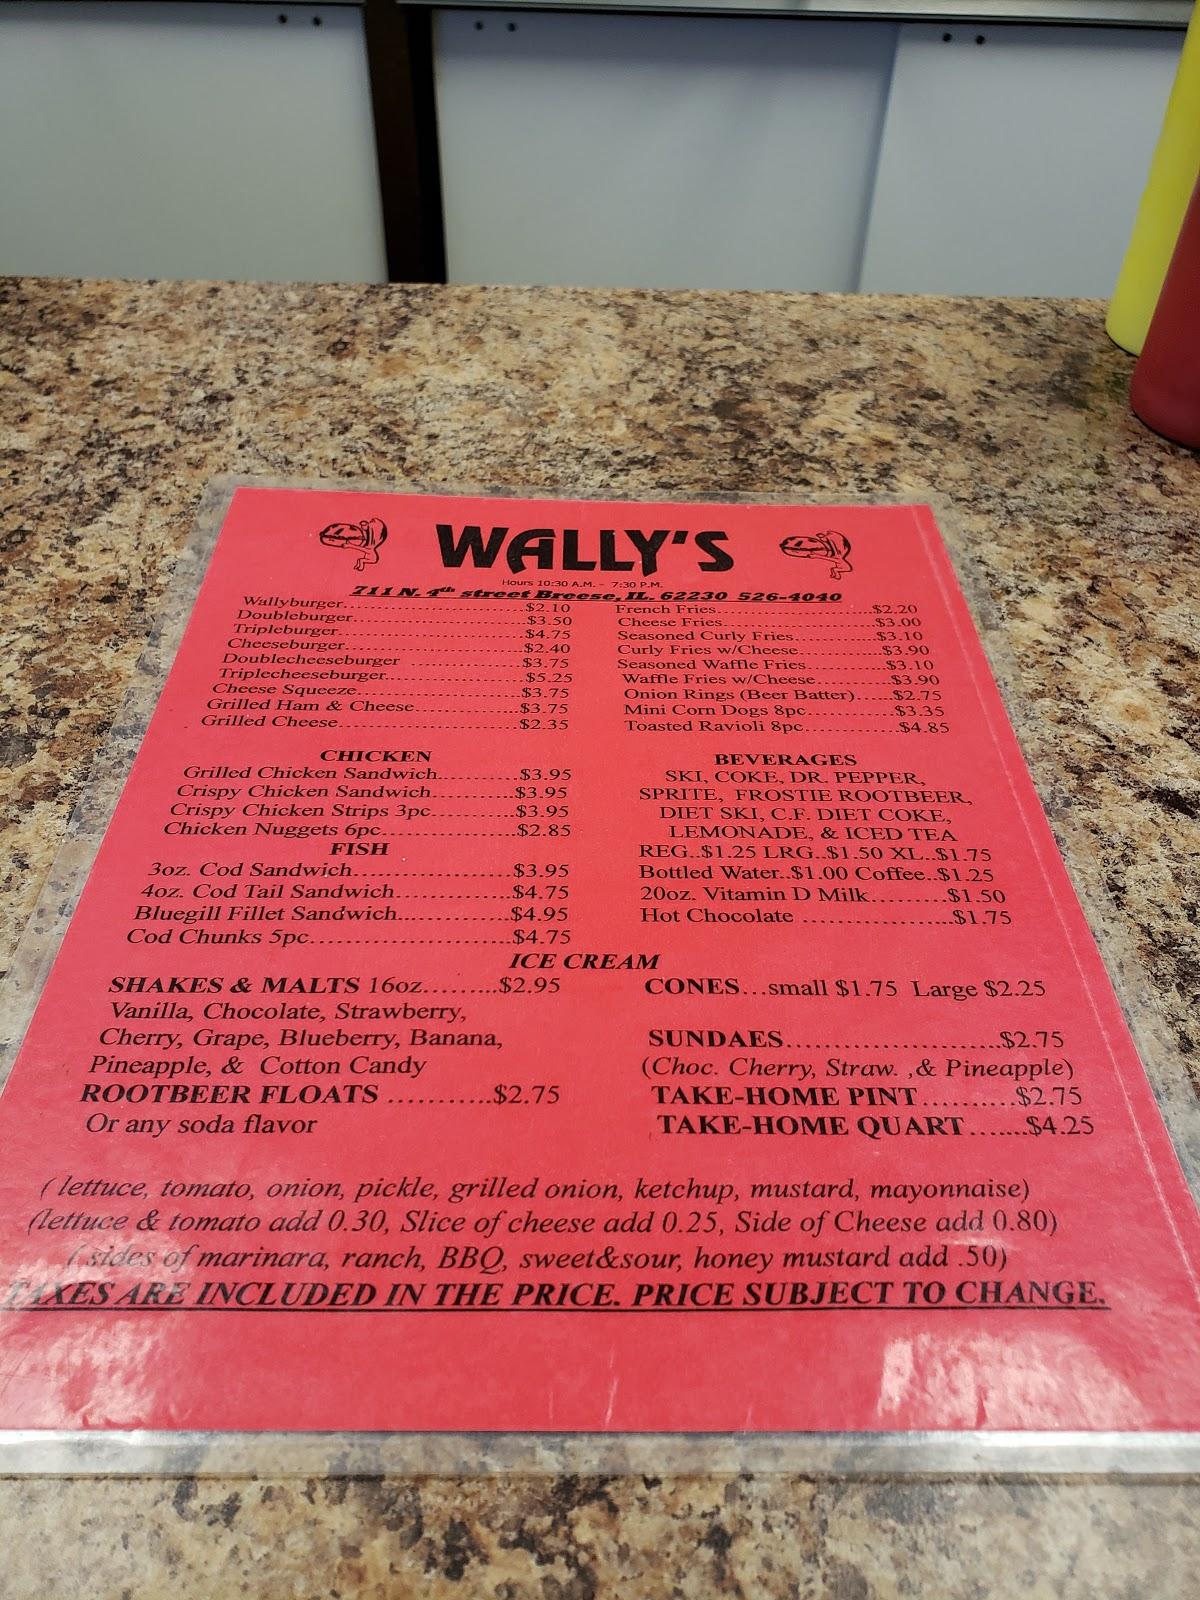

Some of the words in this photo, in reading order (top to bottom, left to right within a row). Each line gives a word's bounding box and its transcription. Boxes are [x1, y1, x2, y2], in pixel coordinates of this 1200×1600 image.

[436, 524, 734, 577] WALLY'S
[352, 585, 394, 596] 711
[399, 587, 421, 597] N.
[461, 588, 531, 599] street
[534, 589, 620, 602] Breese,
[625, 591, 655, 601] IL.
[660, 591, 729, 601] 62230
[737, 591, 843, 602] 526-4040
[244, 596, 343, 609] Wallyburger
[526, 603, 570, 612] $2.10
[615, 605, 671, 614] French
[676, 605, 716, 614] Fries
[872, 605, 917, 614] $2.20
[237, 610, 353, 623] Doubleburger
[527, 616, 572, 625] $3.50
[618, 618, 676, 626] Cheese
[682, 618, 722, 626] Fries
[876, 618, 921, 627] $3.00
[234, 624, 338, 637] Tripleburger
[525, 629, 570, 639] $4.75
[228, 638, 345, 652] Cheeseburger
[524, 643, 570, 654] $2.40
[618, 645, 664, 656] Curly
[670, 645, 711, 654] Fries
[717, 645, 798, 655] w/Cheese
[882, 646, 929, 656] $3.90
[223, 654, 400, 667] Doublecheeseburger
[522, 657, 568, 668] $3.75
[220, 668, 388, 682] Triplecheeseburger
[526, 672, 572, 683] $5.25
[212, 683, 277, 694] Cheese
[282, 684, 356, 697] Squeeze
[522, 687, 568, 698] $3.75
[624, 689, 677, 699] Onion
[683, 689, 734, 702] Rings
[740, 689, 788, 702] (Beer
[793, 690, 854, 702] Batter)
[892, 690, 941, 701] $2.75
[624, 704, 666, 715] Mini
[672, 704, 716, 715] Corn
[721, 705, 768, 718] Dogs
[774, 705, 806, 718] 8pc
[894, 705, 944, 717] $3.35
[201, 715, 266, 726] Grilled
[272, 716, 338, 727] Cheese
[520, 719, 568, 730] $2.35
[624, 720, 692, 731] Toasted
[700, 720, 764, 731] Ravioli
[771, 721, 803, 734] 8pc
[899, 722, 949, 733] $4.85
[320, 750, 432, 762] CHICKEN
[715, 754, 857, 766] BEVERAGES
[184, 766, 252, 778] Grilled
[258, 767, 336, 778] Chicken
[344, 767, 437, 780] Sandwich
[520, 769, 571, 781] $3.95
[666, 770, 708, 784] SKI,
[715, 771, 784, 784] COKE,
[790, 772, 828, 783] DR.
[834, 772, 926, 786] PEPPER,
[640, 788, 724, 802] SPRITE,
[736, 789, 832, 801] FROSTIE
[837, 790, 972, 805] ROOTBEER,
[171, 803, 235, 819] Crispy
[242, 804, 324, 816] Chicken
[332, 804, 388, 820] Strips
[395, 804, 430, 820] 3pc
[516, 804, 568, 818] $3.95
[164, 822, 246, 835] Chicken
[253, 823, 338, 838] Nuggets
[345, 823, 381, 840] 6pc
[517, 824, 570, 837] $2.85
[669, 826, 814, 841] LEMONADE,
[820, 827, 839, 839] &
[844, 827, 903, 840] ICED
[908, 828, 958, 841] TEA
[329, 842, 390, 855] FISH
[148, 862, 190, 876] 3oz.
[200, 862, 244, 876] Cod
[250, 863, 352, 878] Sandwich
[514, 863, 568, 878] $3.95
[641, 886, 696, 900] 20oz.
[702, 887, 787, 901] Vitamin
[792, 887, 811, 900] D
[818, 888, 870, 902] Milk
[947, 888, 1006, 903] $1.50
[134, 906, 222, 924] Bluegill
[227, 906, 285, 920] Fillet
[292, 906, 397, 920] Sandwich
[511, 906, 568, 922] $4.95
[640, 908, 680, 922] Hot
[687, 908, 793, 922] Chocolate
[952, 910, 1011, 925] $1.75
[127, 929, 173, 944] Cod
[179, 929, 262, 944] Chunks
[269, 930, 309, 947] 5pc
[513, 929, 570, 945] $4.75
[508, 953, 557, 969] ICE
[564, 954, 660, 970] CREAM
[108, 977, 224, 993] SHAKES
[230, 977, 252, 993] &
[260, 977, 360, 994] MALTS
[369, 977, 422, 993] 16oz
[499, 976, 560, 994] $2.95
[111, 1002, 193, 1022] Vanilla,
[204, 1002, 326, 1022] Chocolate,
[335, 1003, 466, 1023] Strawberry,
[649, 1030, 784, 1048] SUNDAES
[1000, 1031, 1064, 1050] $2.75
[88, 1056, 211, 1079] Pineapple,
[221, 1056, 244, 1074] &
[260, 1056, 340, 1074] Cotton
[350, 1056, 426, 1078] Candy
[80, 1084, 251, 1104] ROOTBEER
[259, 1084, 378, 1104] FLOATS
[494, 1084, 559, 1104] $2.75
[651, 1086, 839, 1106] TAKE-HOME
[846, 1087, 917, 1106] PINT
[1016, 1086, 1082, 1108] $2.75
[86, 1113, 120, 1132] Or
[125, 1119, 172, 1138] any
[178, 1114, 234, 1134] soda
[242, 1114, 318, 1134] flavor
[657, 1115, 848, 1136] TAKE-HOME
[857, 1116, 964, 1140] QUART
[1026, 1116, 1094, 1136] $4.25
[58, 1175, 147, 1199] lettuce,
[160, 1180, 254, 1200] tomato,
[267, 1178, 344, 1200] onion,
[354, 1177, 438, 1202] pickle,
[448, 1177, 539, 1203] grilled
[545, 1180, 622, 1202] onion,
[634, 1178, 739, 1204] ketchup,
[751, 1178, 859, 1201] mustard,
[871, 1179, 1029, 1204] mayonnaise)
[113, 1282, 191, 1305] ARE
[193, 1282, 377, 1306] INCLUDED
[383, 1284, 427, 1306] IN
[434, 1283, 504, 1306] THE
[509, 1281, 622, 1306] PRICE.
[631, 1283, 734, 1307] PRICE
[742, 1281, 894, 1306] SUBJECT
[903, 1281, 946, 1306] TO
[955, 1281, 1106, 1306] CHANGE.
